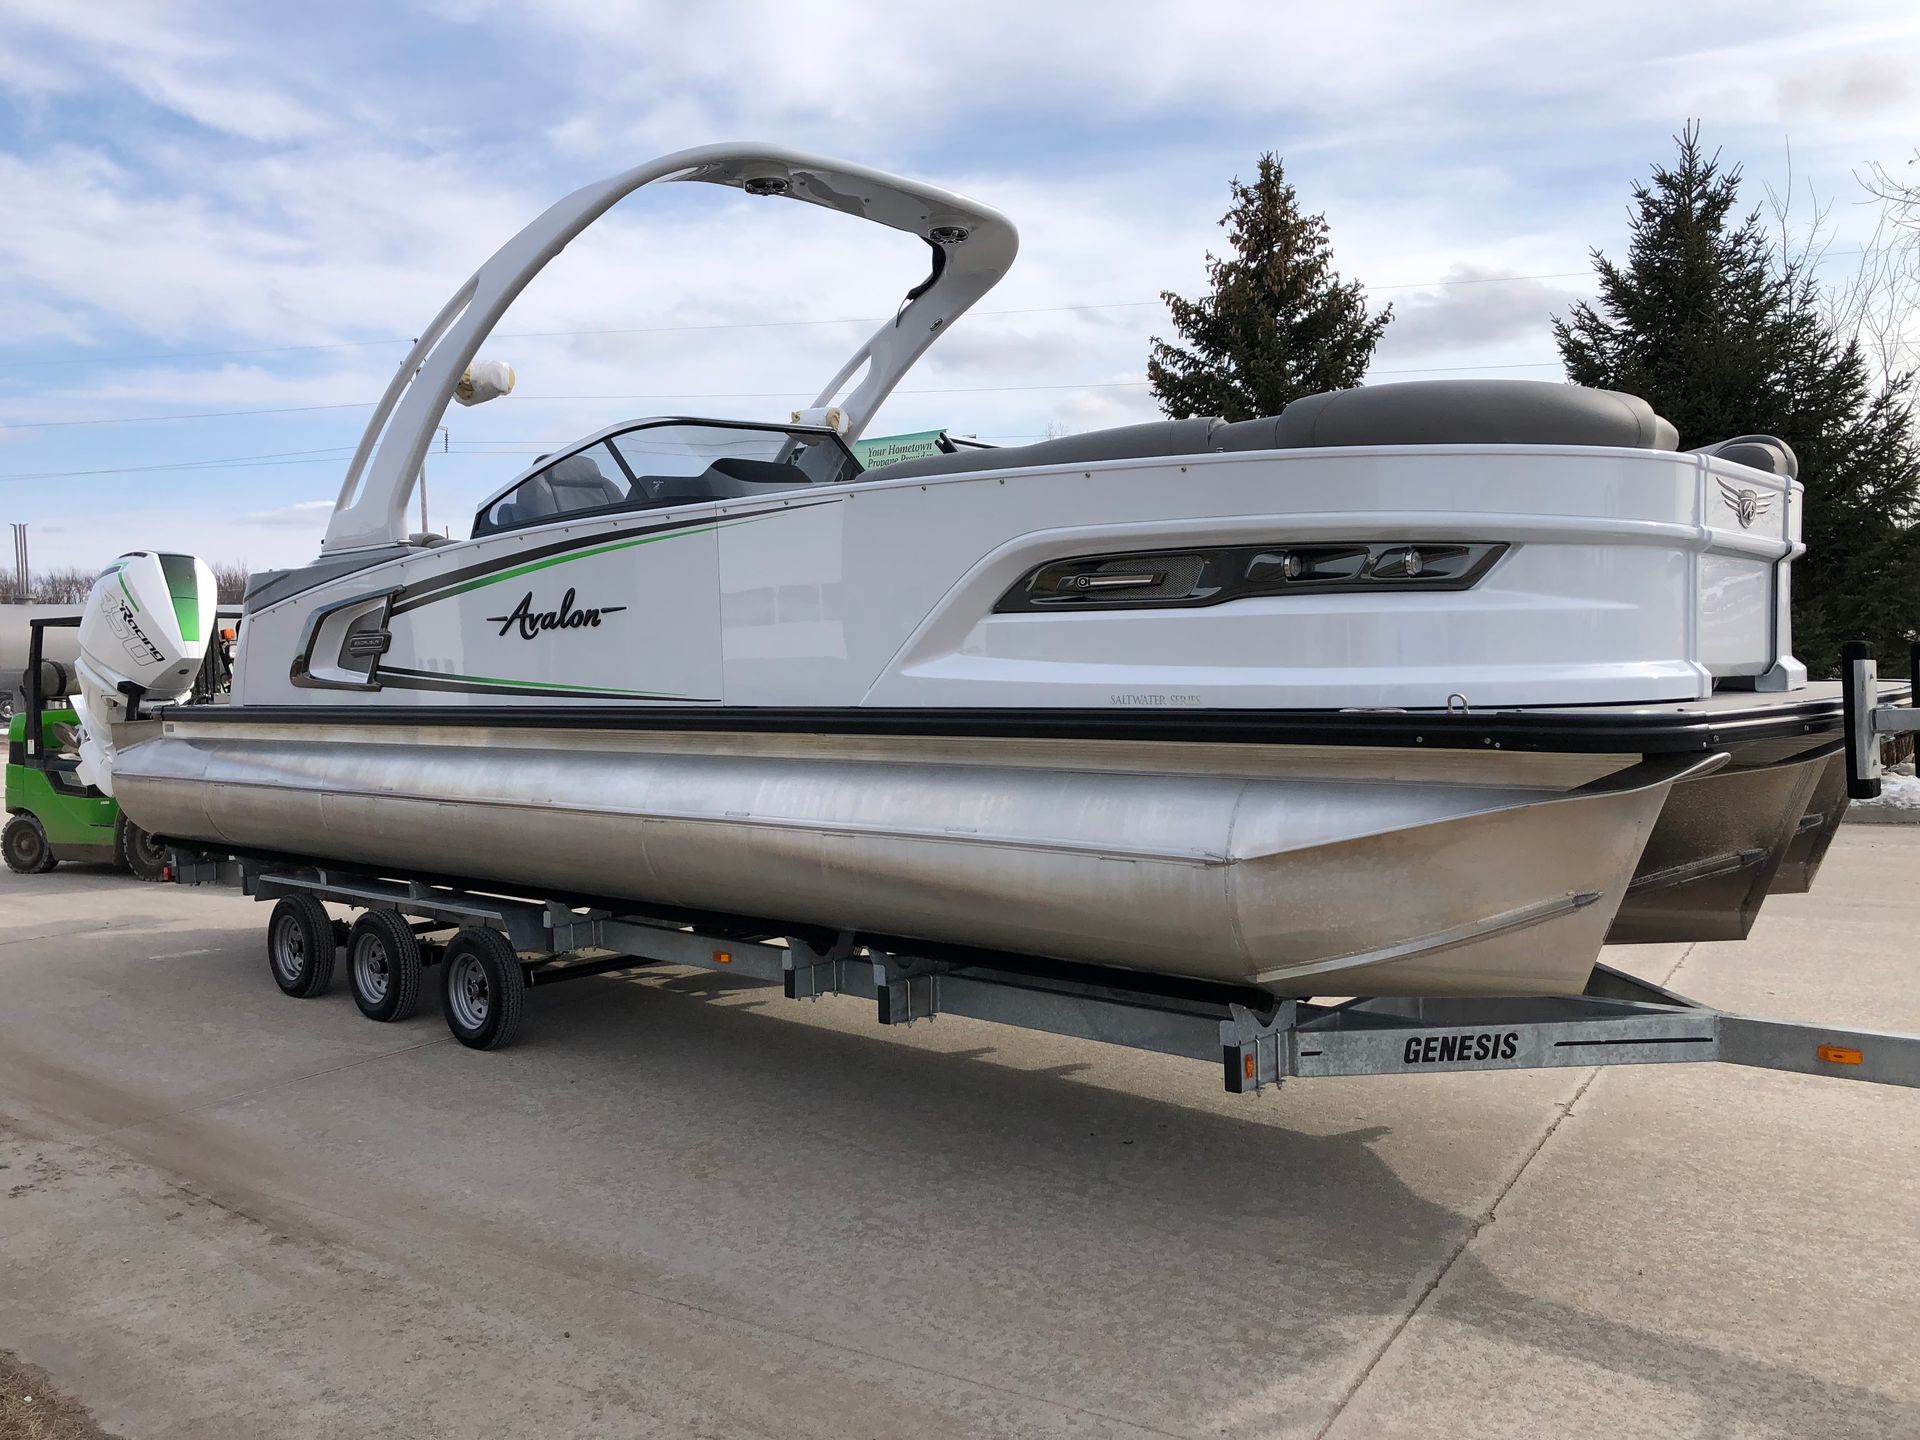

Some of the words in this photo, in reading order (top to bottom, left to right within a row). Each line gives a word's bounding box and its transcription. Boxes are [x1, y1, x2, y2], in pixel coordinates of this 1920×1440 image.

[868, 447, 886, 457] Your
[888, 443, 932, 455] Hometown
[100, 585, 157, 666] 450
[119, 604, 166, 662] Racing
[498, 587, 602, 640] Avalon
[1110, 694, 1167, 706] SALTWATER
[1170, 694, 1201, 706] SERIES
[1403, 1032, 1519, 1064] GENESIS
